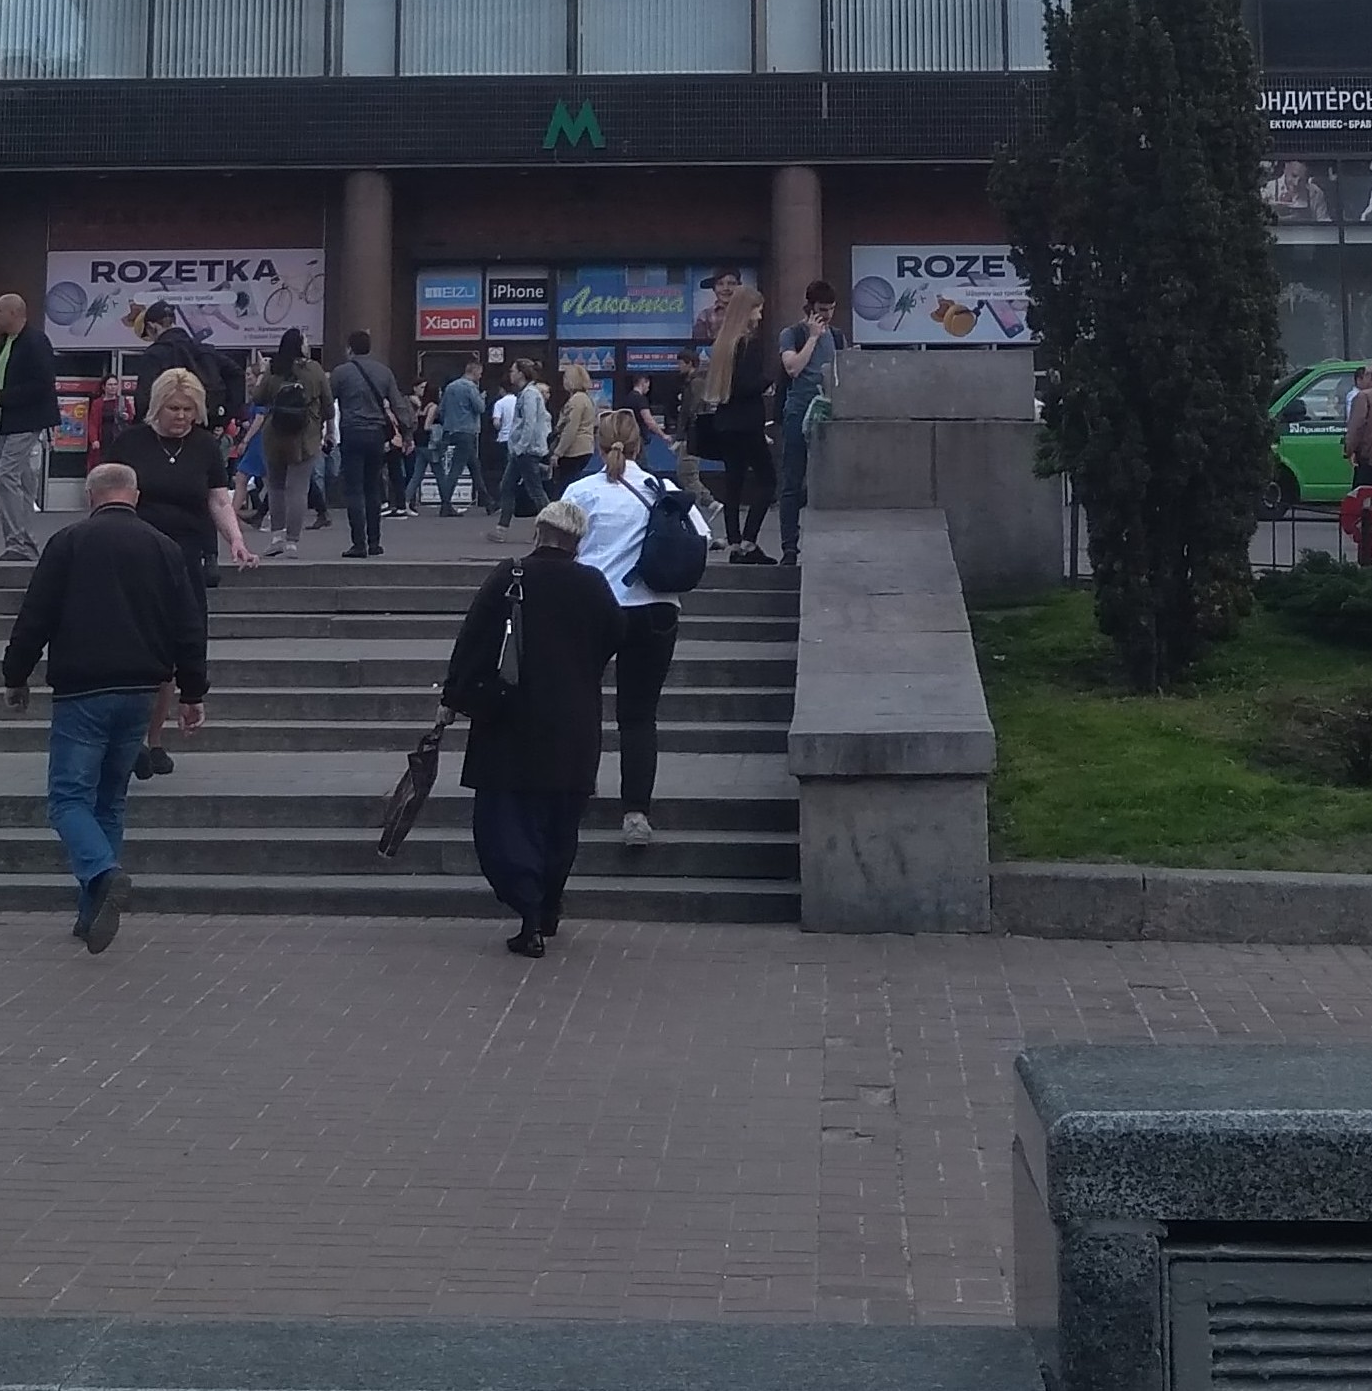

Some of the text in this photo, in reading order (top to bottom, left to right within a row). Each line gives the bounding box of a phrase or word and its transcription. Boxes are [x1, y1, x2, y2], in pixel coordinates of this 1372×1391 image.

[91, 258, 281, 284] ROZETKA
[493, 283, 545, 298] iPhone
[425, 315, 476, 329] Xiaomi
[492, 317, 545, 327] SAMSUNG
